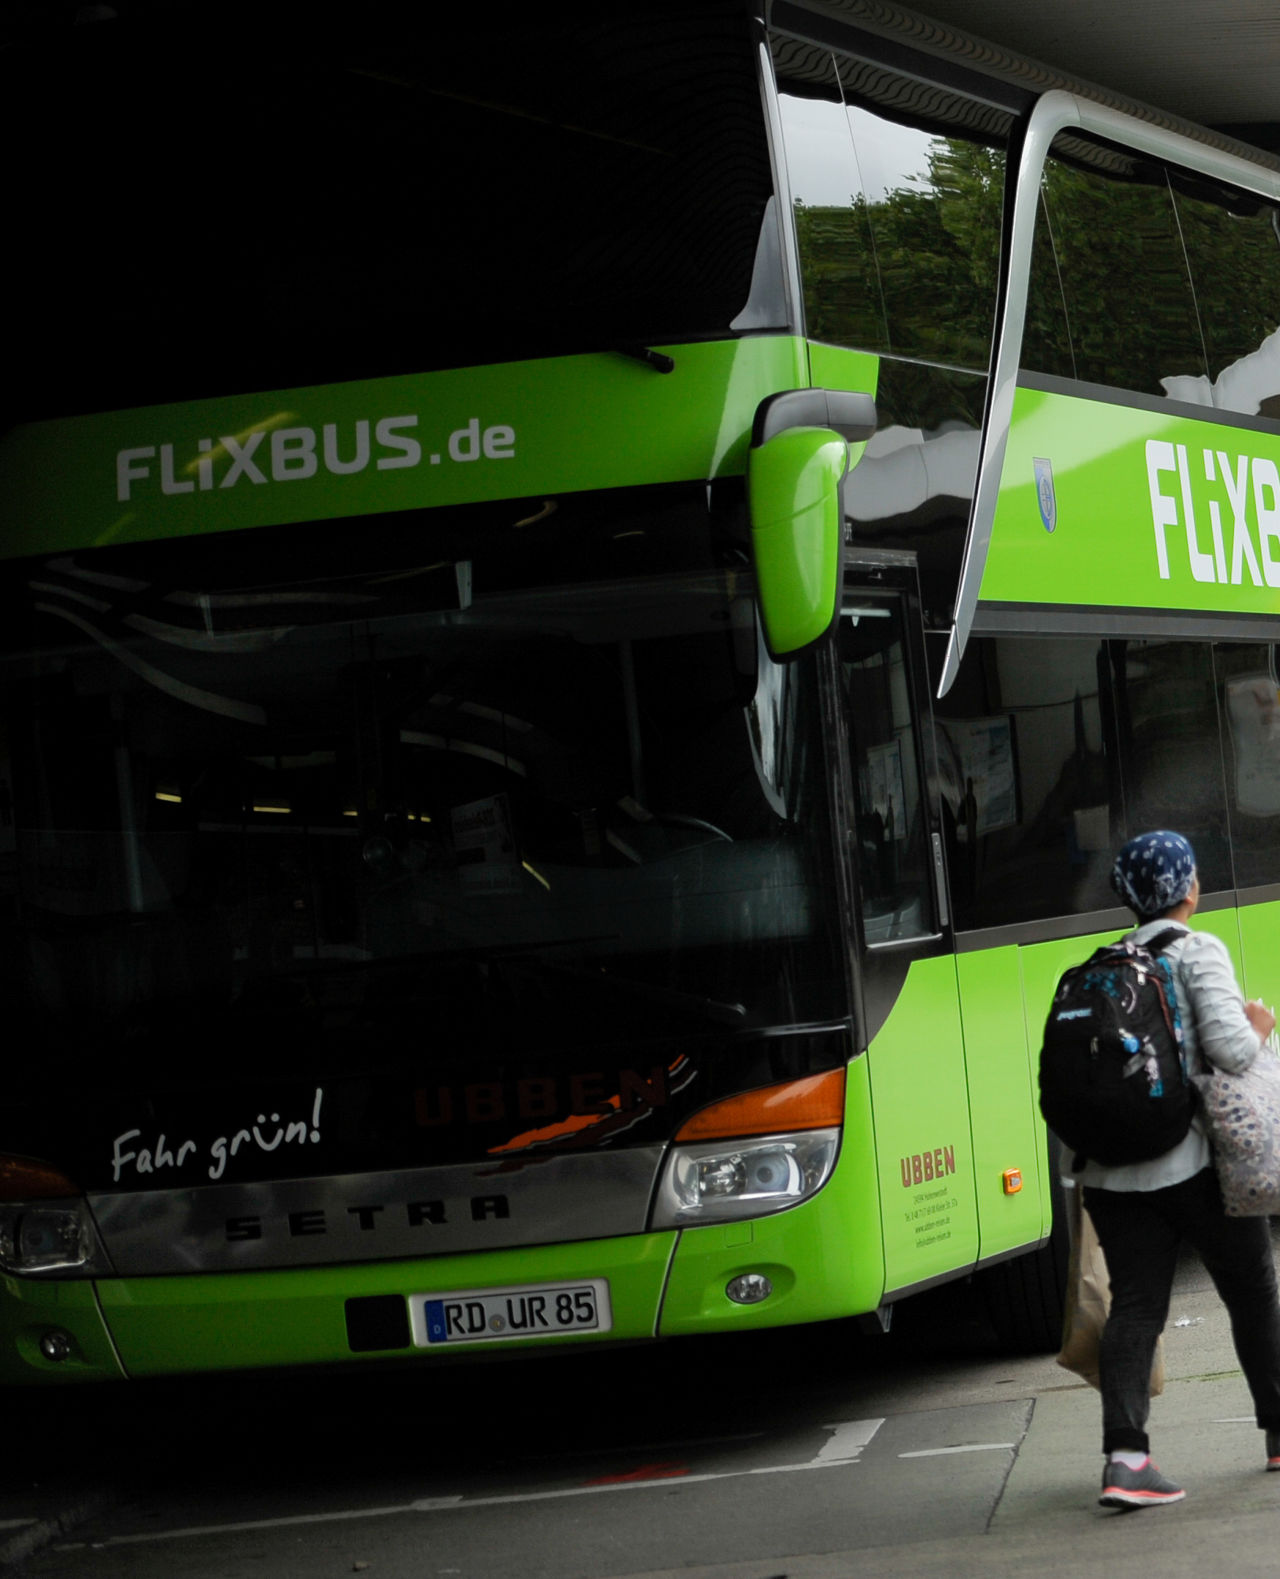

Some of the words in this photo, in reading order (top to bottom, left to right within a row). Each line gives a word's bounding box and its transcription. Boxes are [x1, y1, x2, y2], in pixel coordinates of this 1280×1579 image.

[412, 1064, 667, 1128] UBBEN
[111, 1127, 198, 1183] Fahr
[207, 1086, 323, 1181] grün!
[900, 1144, 955, 1188] UBBEN
[225, 1194, 511, 1241] SETRA
[445, 1302, 486, 1335] RD
[506, 1296, 548, 1329] UR
[556, 1292, 594, 1325] 85
